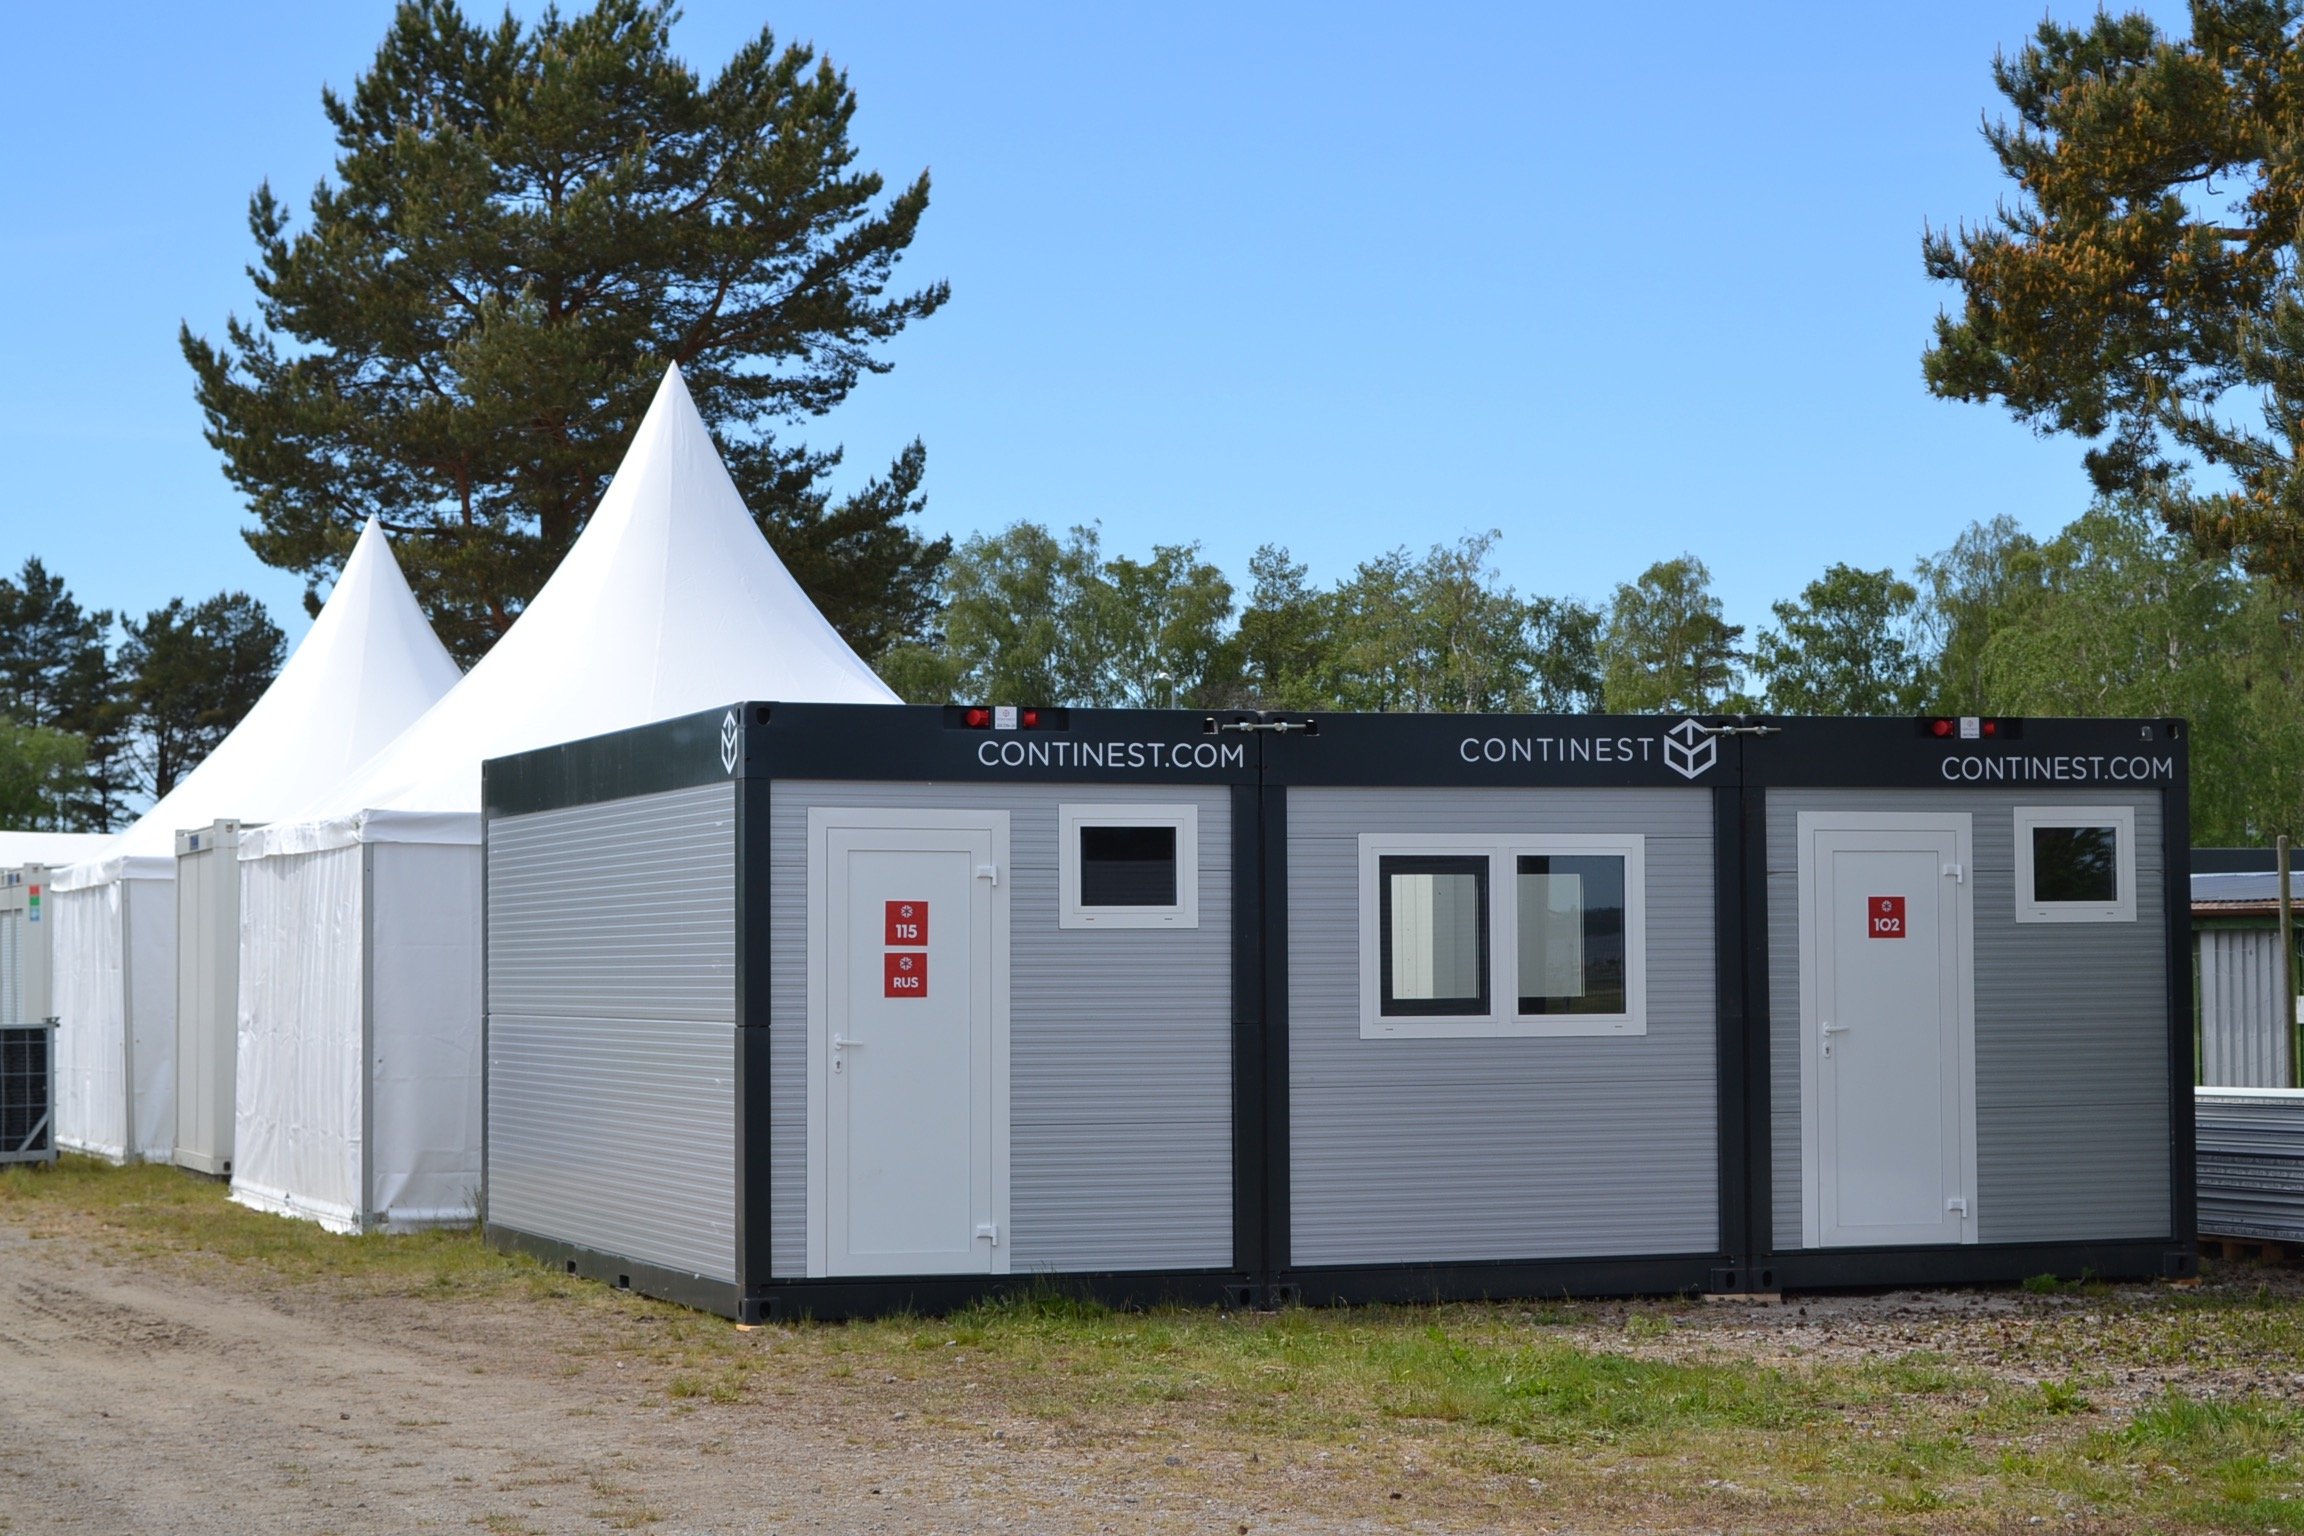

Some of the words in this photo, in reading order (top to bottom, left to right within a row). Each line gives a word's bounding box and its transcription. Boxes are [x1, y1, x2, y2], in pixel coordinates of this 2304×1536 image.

[978, 740, 1244, 768] CONTINEST.COM
[1460, 737, 1655, 762] CONTINEST
[1941, 756, 2173, 780] CONTINEST.COM
[895, 924, 918, 939] 115
[1873, 917, 1900, 932] 102
[893, 976, 919, 988] RUS
